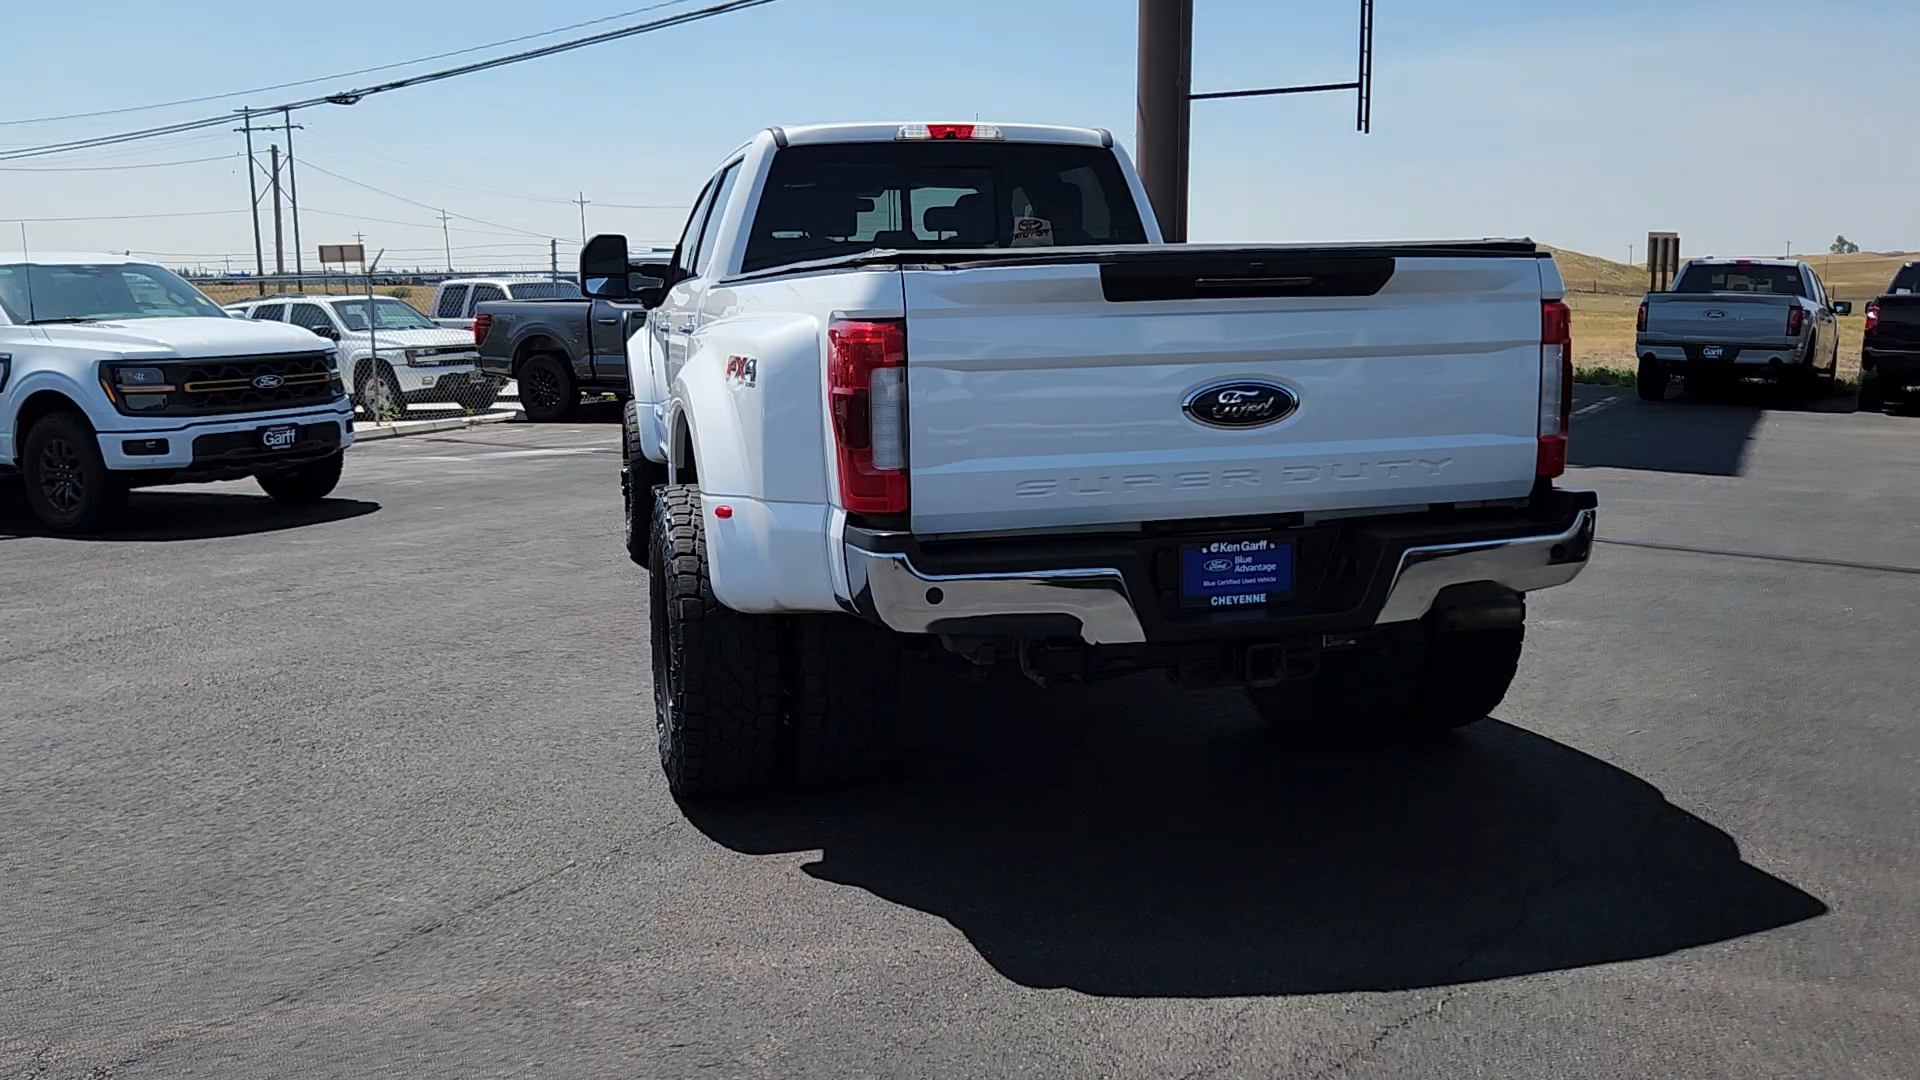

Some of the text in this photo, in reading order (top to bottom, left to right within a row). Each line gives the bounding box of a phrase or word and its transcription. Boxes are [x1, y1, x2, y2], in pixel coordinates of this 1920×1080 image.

[1212, 389, 1275, 418] Ford
[263, 429, 296, 446] Garff
[1015, 456, 1454, 499] SUPER DUTY
[1219, 539, 1268, 553] Ken Garff
[1208, 560, 1228, 571] Ford
[1234, 555, 1253, 564] Blue
[1234, 563, 1277, 573] Advantage
[1210, 593, 1267, 606] CHEYENNE
